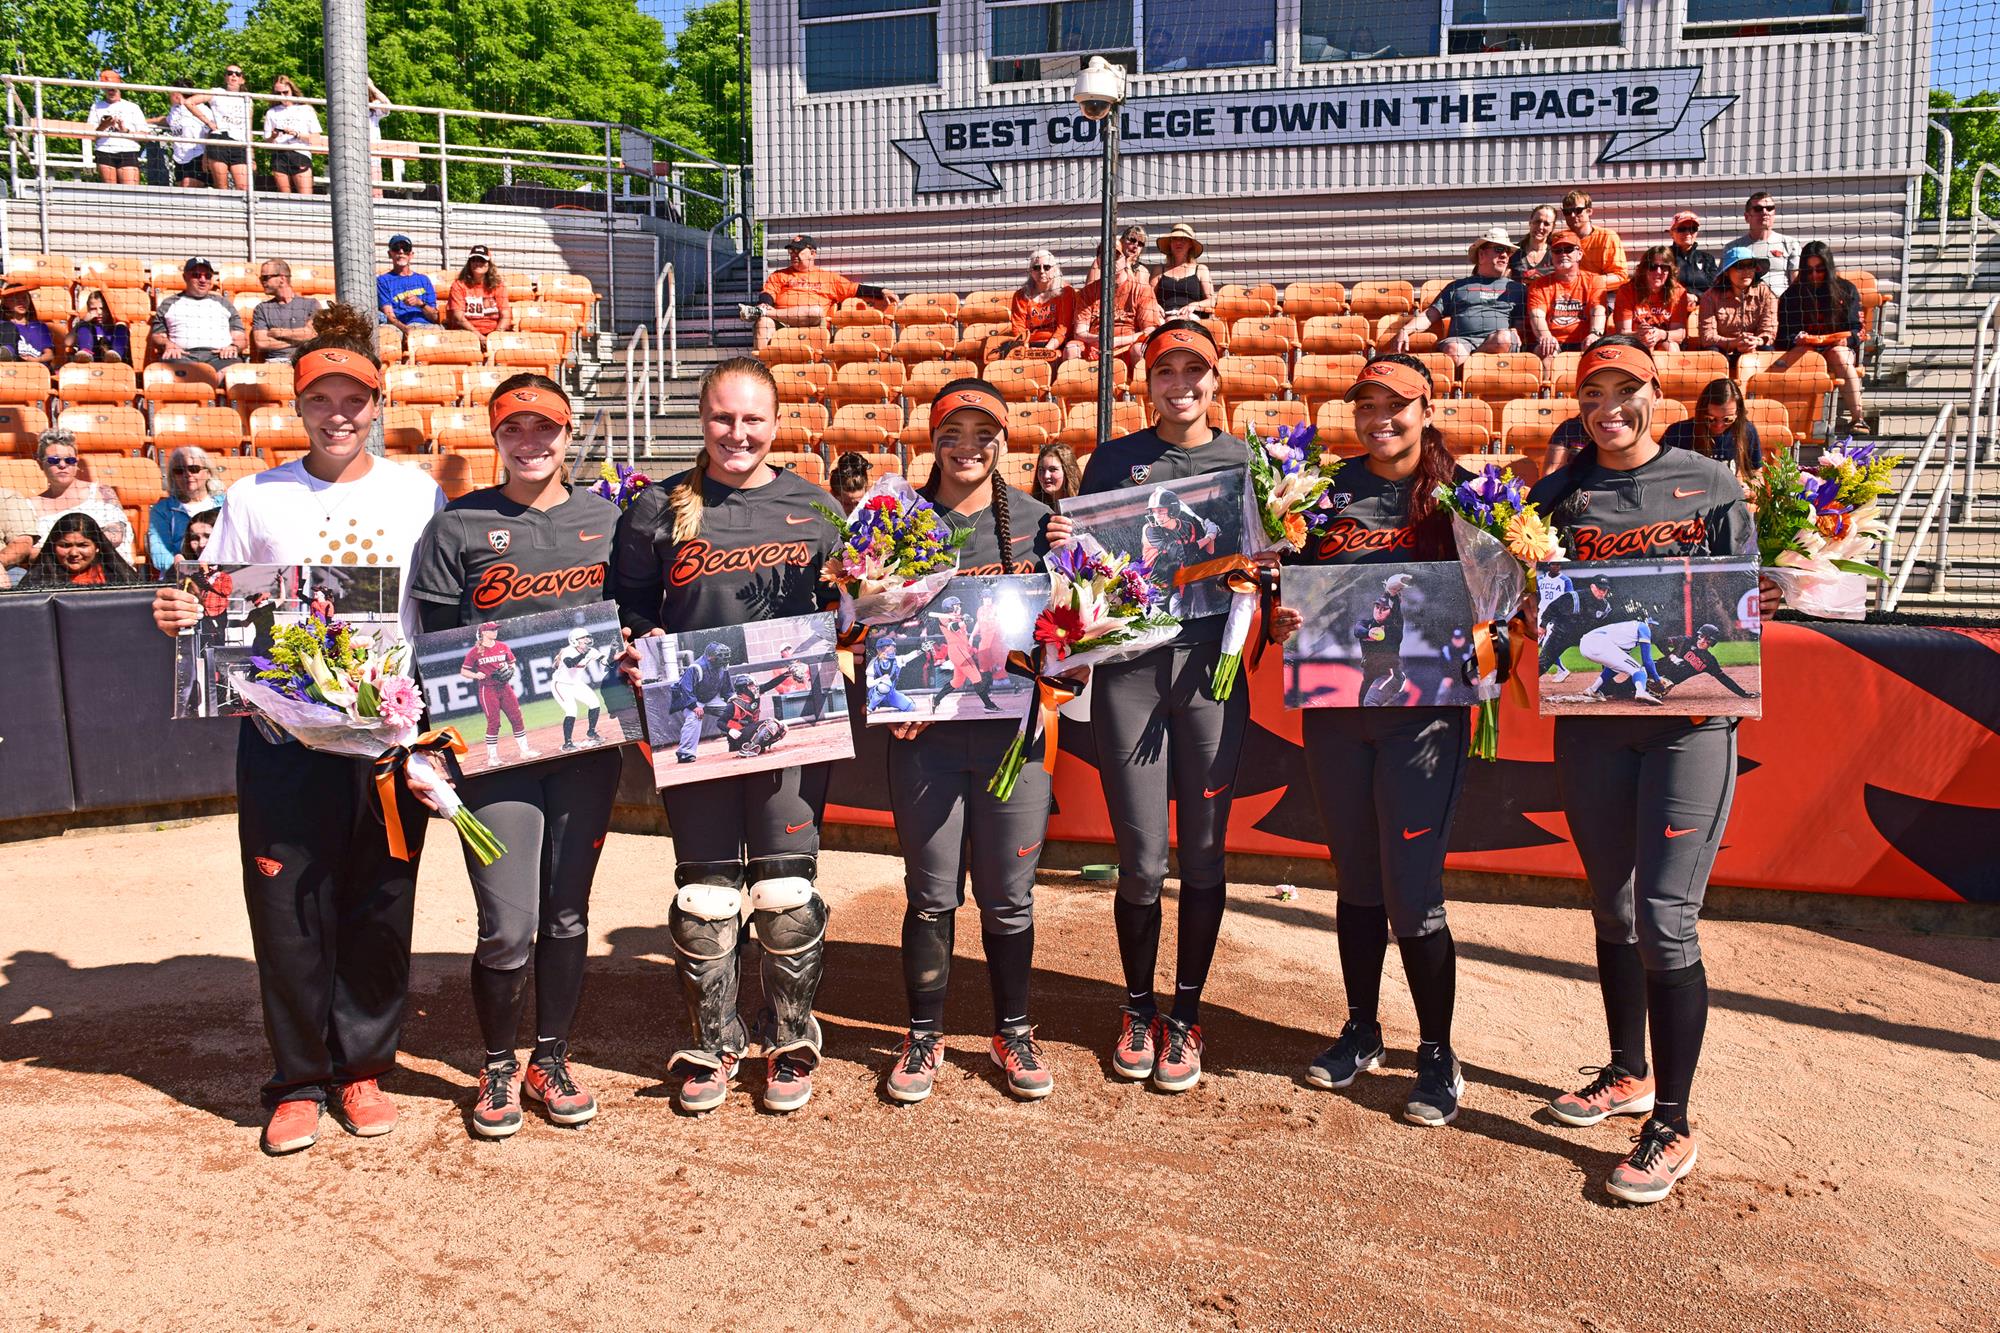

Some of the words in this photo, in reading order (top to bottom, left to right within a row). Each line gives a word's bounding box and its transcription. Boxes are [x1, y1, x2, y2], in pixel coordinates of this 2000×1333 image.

[944, 118, 1037, 151] BEST
[1047, 108, 1215, 144] COLEGE
[1227, 101, 1348, 135] TOWN
[1360, 98, 1401, 129] IN
[1412, 92, 1498, 126] THE
[1510, 86, 1660, 121] PAC-12
[669, 538, 811, 588] Beavers
